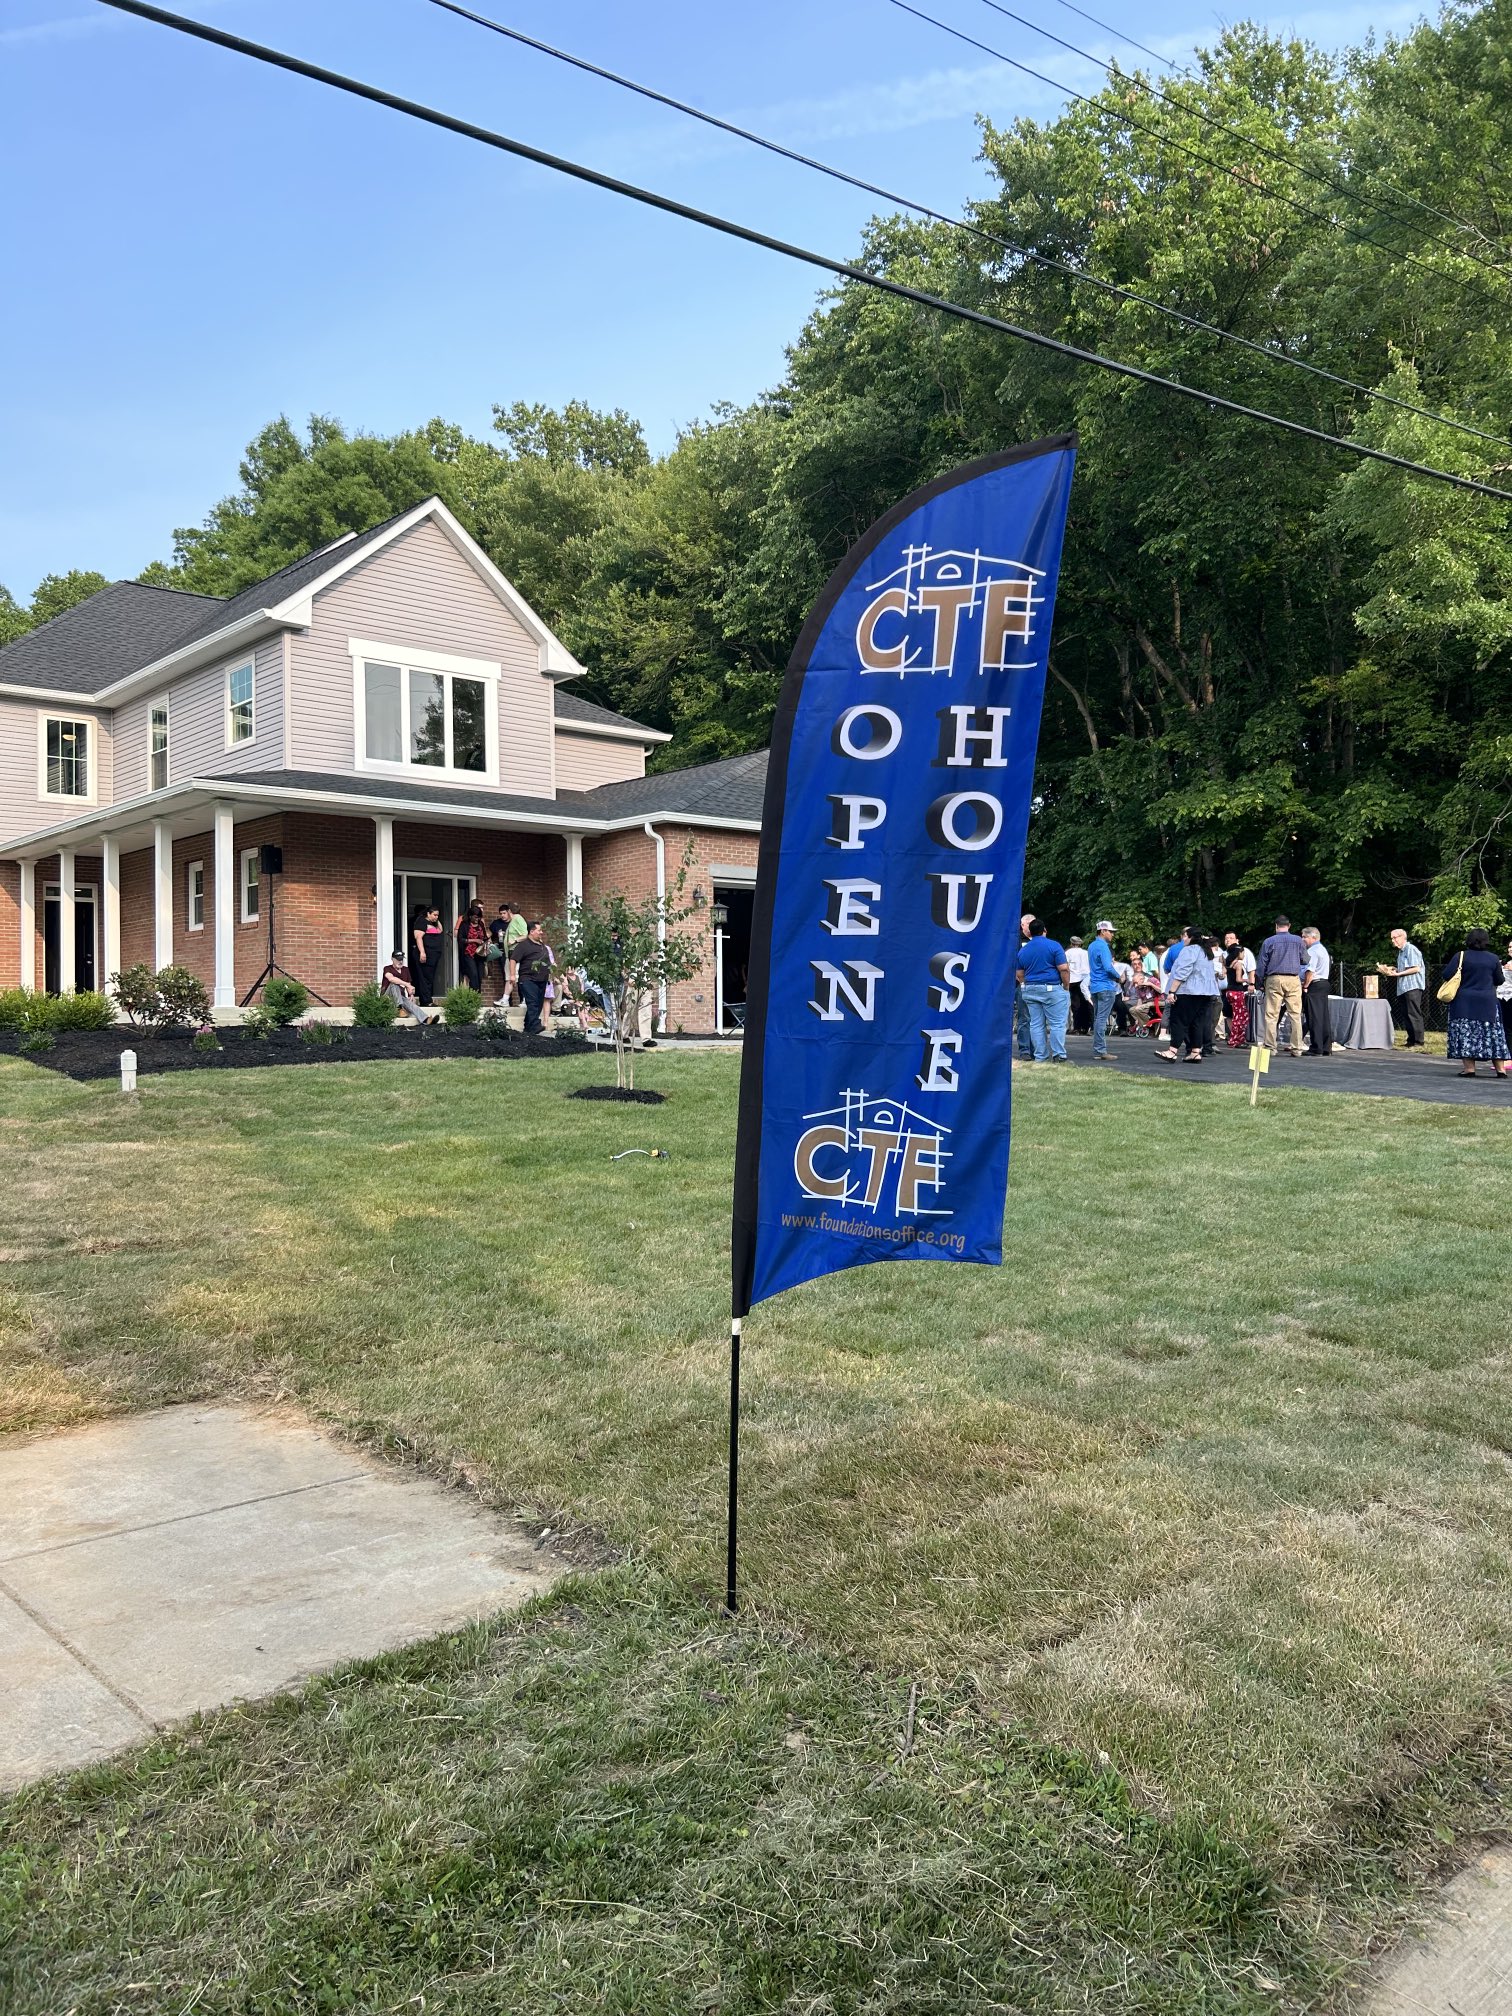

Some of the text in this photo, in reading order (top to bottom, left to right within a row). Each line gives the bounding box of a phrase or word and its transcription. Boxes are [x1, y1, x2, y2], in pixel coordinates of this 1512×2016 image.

[856, 577, 1043, 678] CTF
[808, 704, 903, 1022] OPEN
[914, 704, 1011, 1092] HOUSE
[795, 1125, 953, 1216] CTF
[780, 1211, 966, 1254] www.foundationsoffice.org
